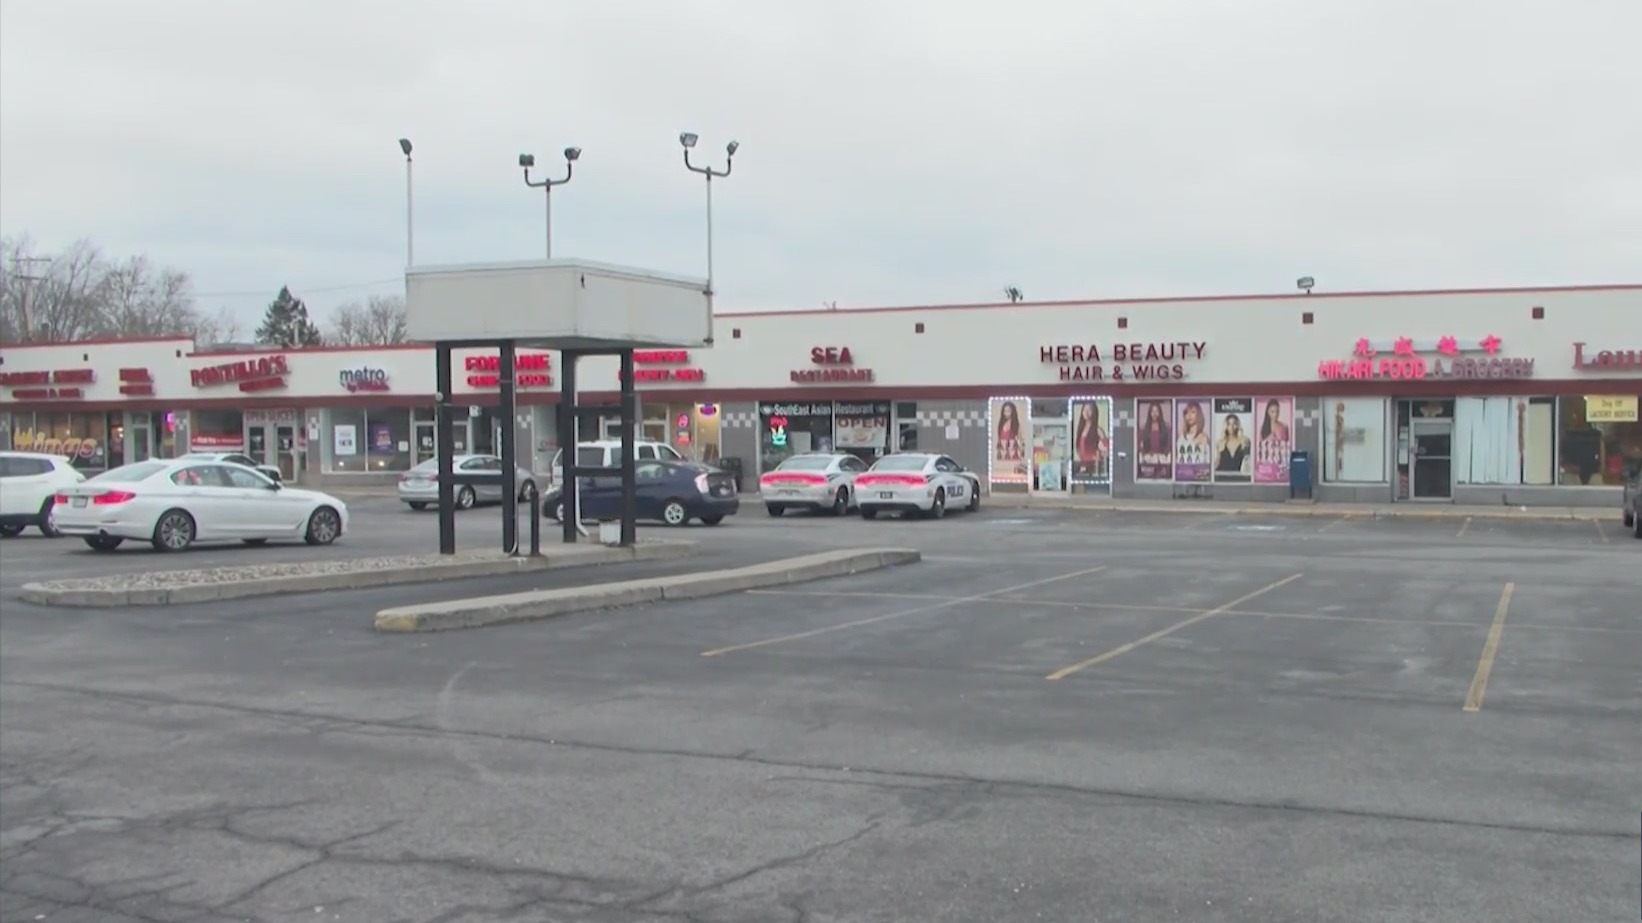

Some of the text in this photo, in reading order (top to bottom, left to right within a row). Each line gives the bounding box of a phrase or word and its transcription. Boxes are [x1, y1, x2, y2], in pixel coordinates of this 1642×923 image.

[811, 346, 853, 364] SEA
[1040, 342, 1207, 363] HERA BEAUTY
[1572, 342, 1642, 369] Lou
[465, 355, 550, 371] FORUNE
[1318, 359, 1374, 379] HIKARI
[1379, 358, 1426, 379] FOOD
[1451, 357, 1535, 378] GROCERY
[339, 365, 385, 382] metro
[1060, 364, 1184, 380] HAIR & WIGS
[774, 404, 874, 416] SouthEast Asian Restaurant
[838, 417, 885, 428] OPEN
